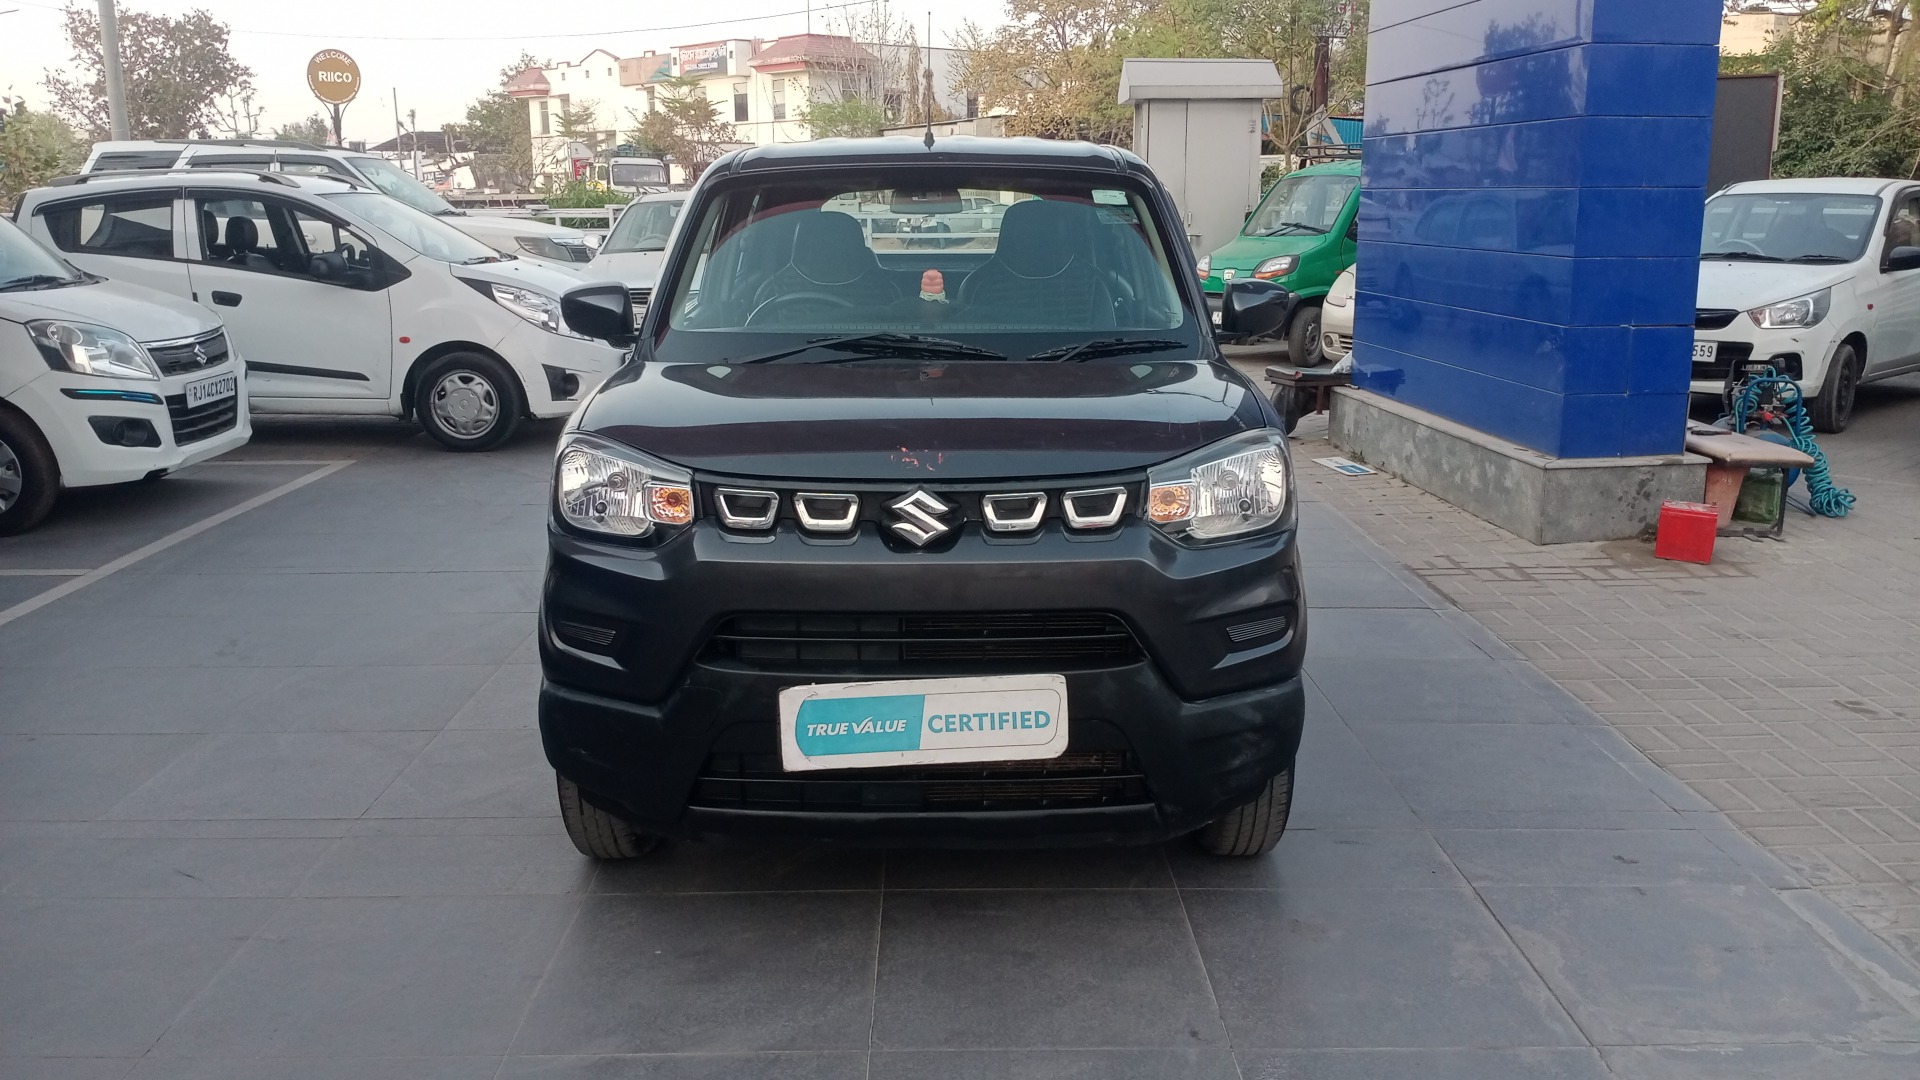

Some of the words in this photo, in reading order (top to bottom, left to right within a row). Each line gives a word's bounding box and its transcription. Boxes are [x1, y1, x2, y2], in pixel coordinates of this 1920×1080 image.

[314, 51, 352, 66] WELCOME
[318, 71, 352, 82] RIICO
[193, 376, 234, 402] RJ14CX2702
[807, 723, 849, 736] TRUE
[852, 716, 907, 734] VALUE
[927, 710, 1051, 733] CERTIFIED
